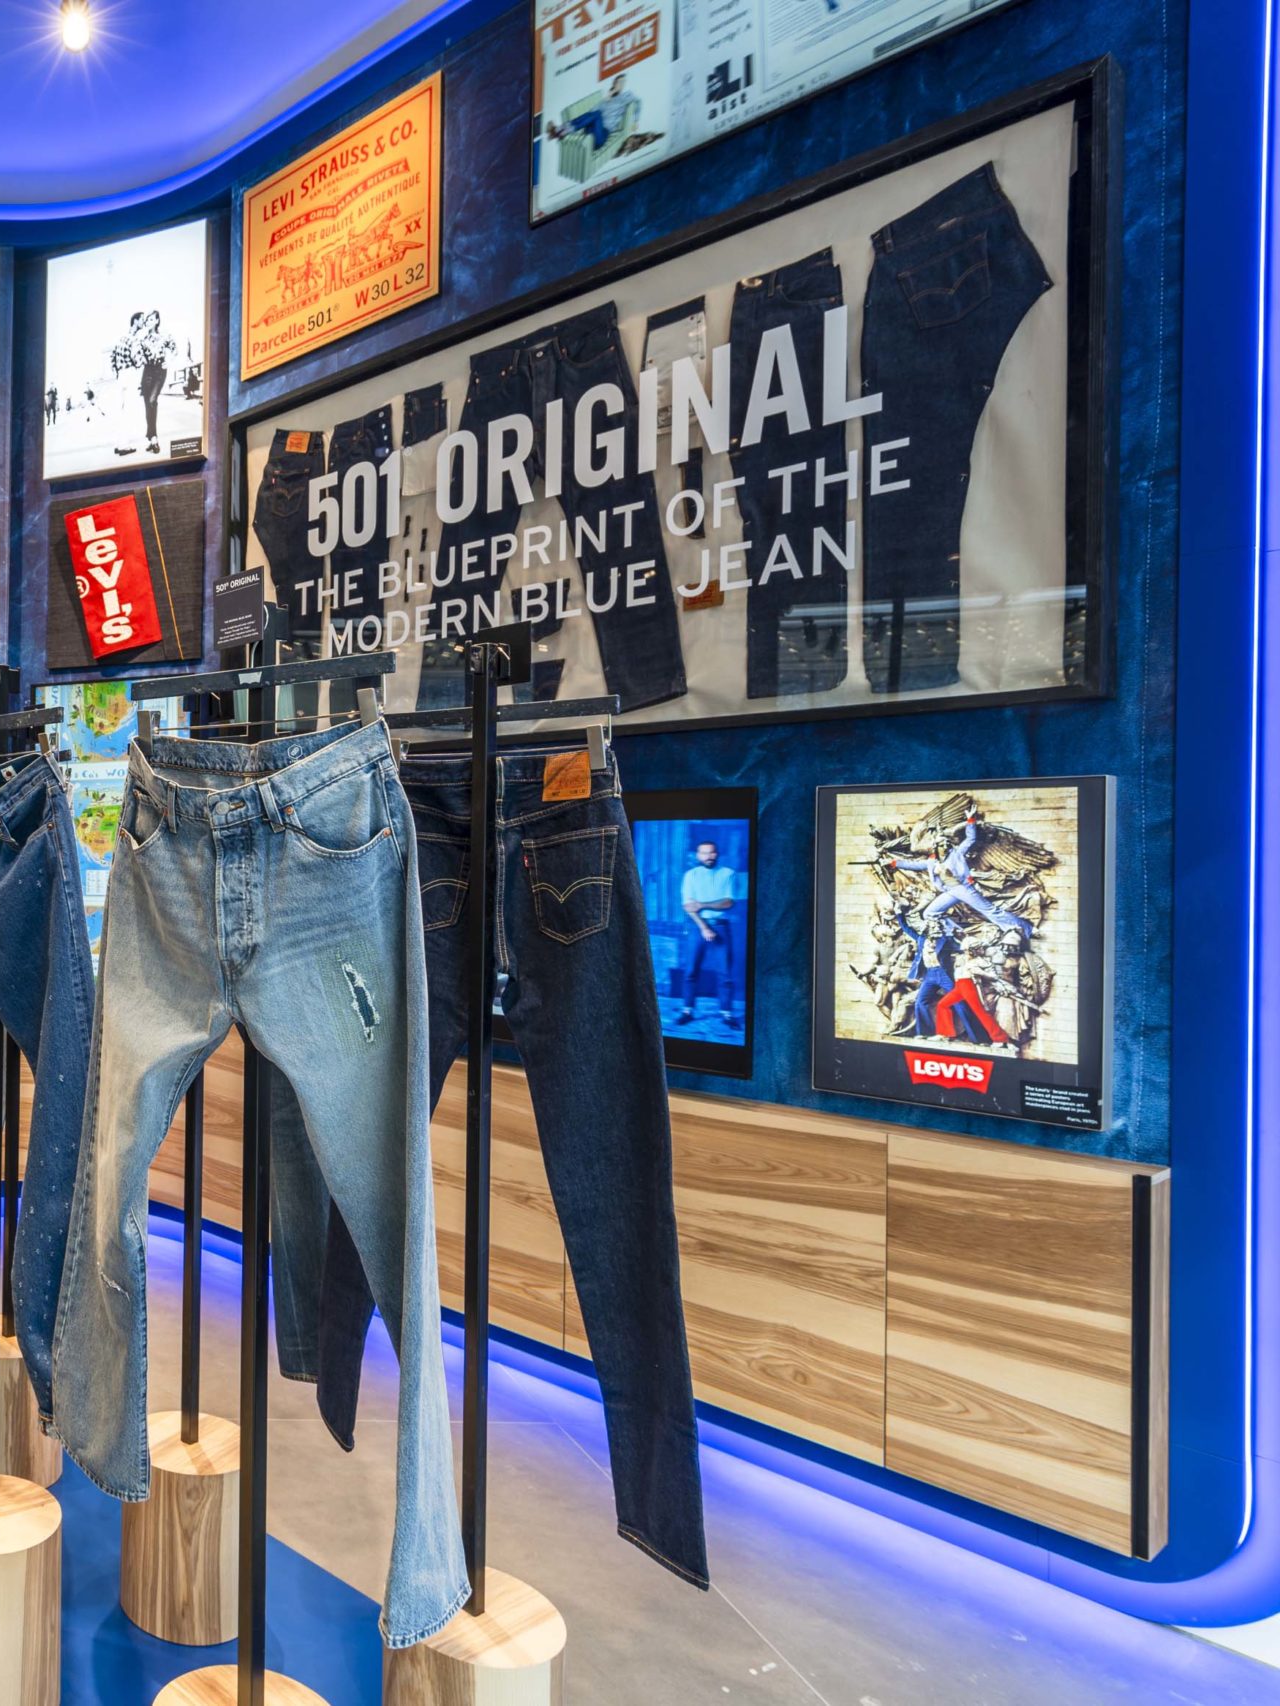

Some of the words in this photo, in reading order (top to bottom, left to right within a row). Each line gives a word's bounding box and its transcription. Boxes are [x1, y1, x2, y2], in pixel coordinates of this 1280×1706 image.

[263, 189, 295, 223] LEVI
[300, 143, 369, 200] STRAUSS
[374, 135, 386, 158] &
[390, 119, 418, 147] CO.
[259, 236, 305, 269] VÊTEMENTS
[306, 230, 317, 243] DE
[320, 214, 354, 240] QUALITÉ
[357, 172, 421, 218] AUTHENTIQUE
[274, 213, 307, 241] COUPE
[404, 217, 423, 237] XX
[252, 322, 306, 358] Parcelle
[355, 288, 370, 309] W
[371, 279, 390, 302] 30
[393, 273, 403, 292] L
[405, 262, 425, 285] 32
[436, 304, 883, 525] ORIGINAL
[294, 568, 365, 616] THE
[378, 500, 645, 601] BLUEPRINT
[665, 476, 746, 537] OF
[767, 437, 911, 514] THE
[229, 573, 261, 589] ORIGINAL
[327, 590, 501, 660] MODERN
[520, 559, 656, 625] BLUE
[676, 520, 856, 598] JEAN
[913, 1058, 985, 1083] Levi's
